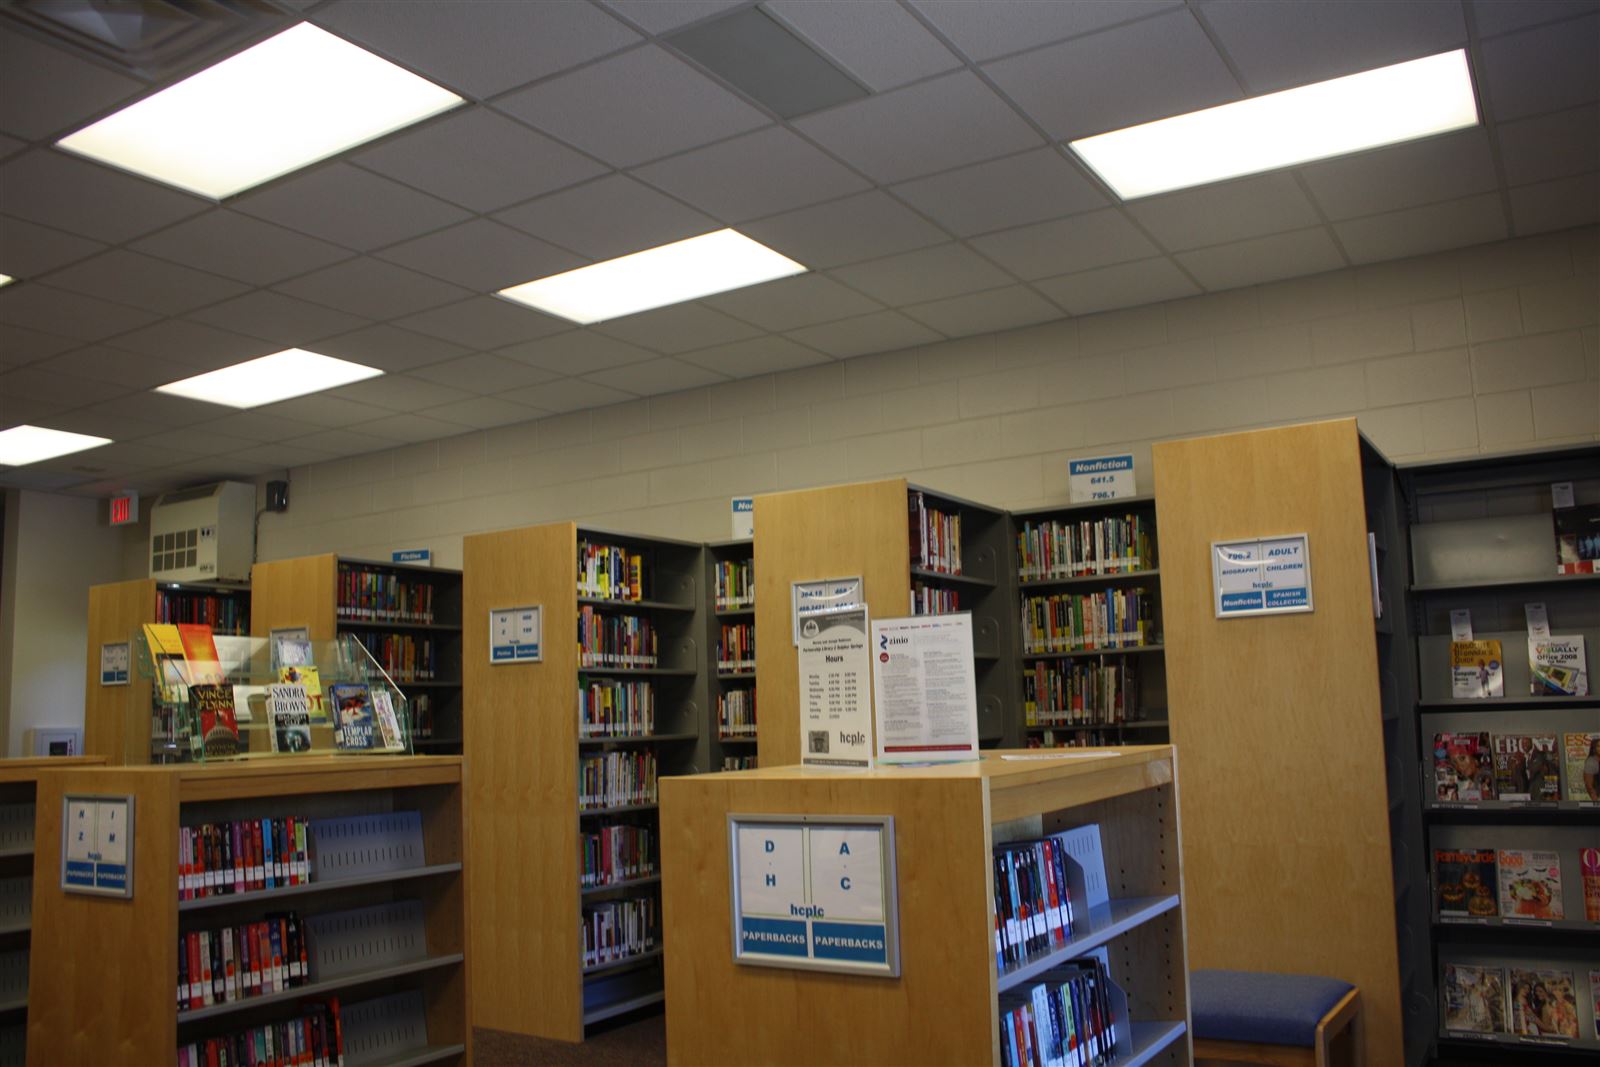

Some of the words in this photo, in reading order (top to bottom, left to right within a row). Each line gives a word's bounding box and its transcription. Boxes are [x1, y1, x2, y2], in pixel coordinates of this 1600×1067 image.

[1075, 460, 1128, 473] Nonfiction
[1268, 546, 1299, 557] ADULT
[1222, 567, 1258, 576] BIOGRAPHY
[1266, 563, 1303, 572] CHILDREN
[1223, 598, 1262, 607] Nonfiction
[1267, 598, 1308, 607] COLLECTION
[889, 637, 908, 646] zinio
[825, 655, 844, 664] Hours
[198, 690, 233, 699] VINCE
[273, 688, 306, 699] SANDRA
[199, 699, 235, 711] FLYNN
[275, 700, 308, 713] BROWN
[343, 726, 373, 737] TEMPLAR
[345, 736, 369, 747] CROSS
[840, 731, 866, 746] hcplc
[1495, 737, 1555, 754] EBONY
[79, 810, 85, 819] N
[765, 840, 775, 853] D
[839, 842, 850, 855] A
[766, 874, 776, 887] H
[840, 877, 851, 890] C
[790, 904, 825, 919] hcplc
[743, 931, 806, 944] PAPERBACKS
[815, 935, 884, 949] PAPERBACKS
